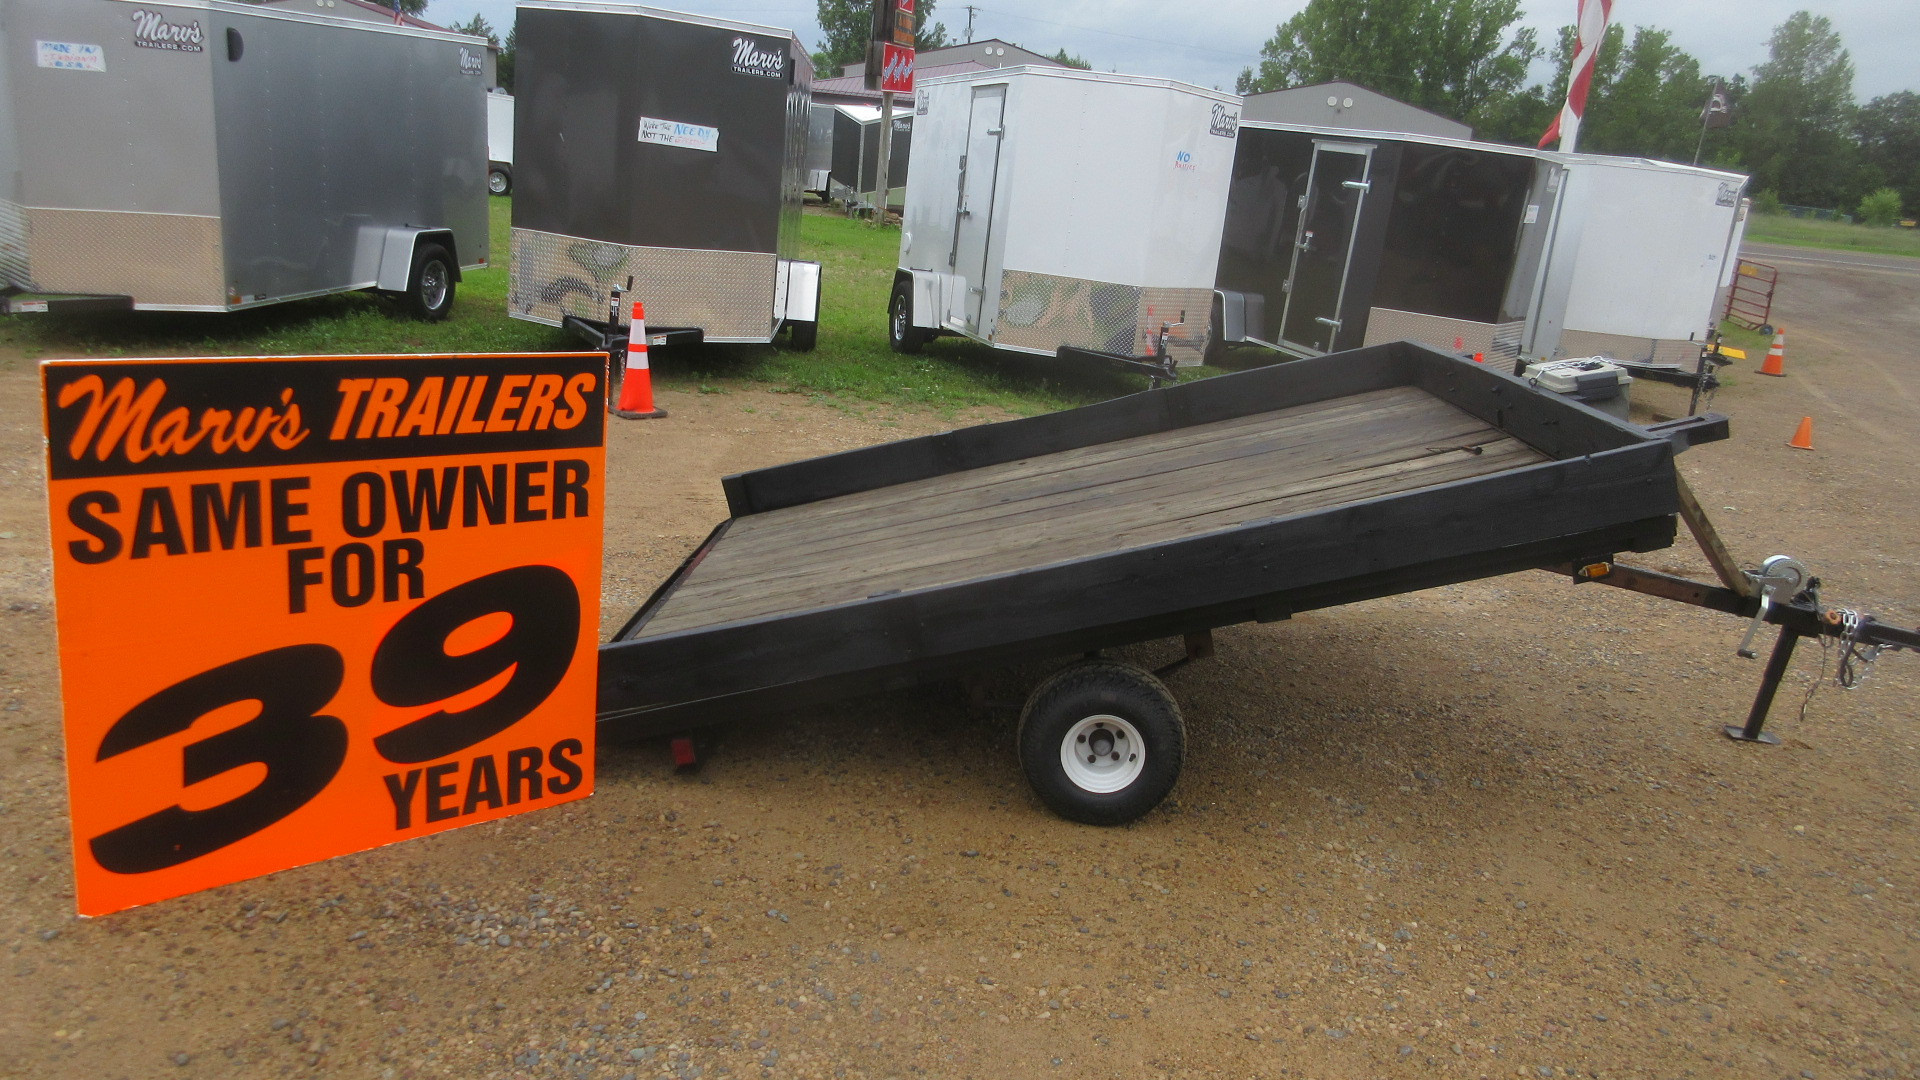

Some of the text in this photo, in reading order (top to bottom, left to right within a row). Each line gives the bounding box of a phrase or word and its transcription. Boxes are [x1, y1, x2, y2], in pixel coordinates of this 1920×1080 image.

[132, 9, 204, 44] Marv's
[137, 40, 201, 52] TRAILERS.COM
[731, 37, 784, 71] Marv's
[734, 66, 781, 78] TRAILERS.COM
[1211, 103, 1238, 131] Marv's
[641, 130, 658, 139] NOT
[660, 133, 674, 143] THE
[1177, 150, 1191, 163] NO
[57, 372, 597, 464] Marv's TRAILERS
[66, 459, 591, 565] SAME OWNER
[287, 538, 426, 615] FOR
[88, 564, 582, 875] 39
[383, 738, 584, 831] YEARS
